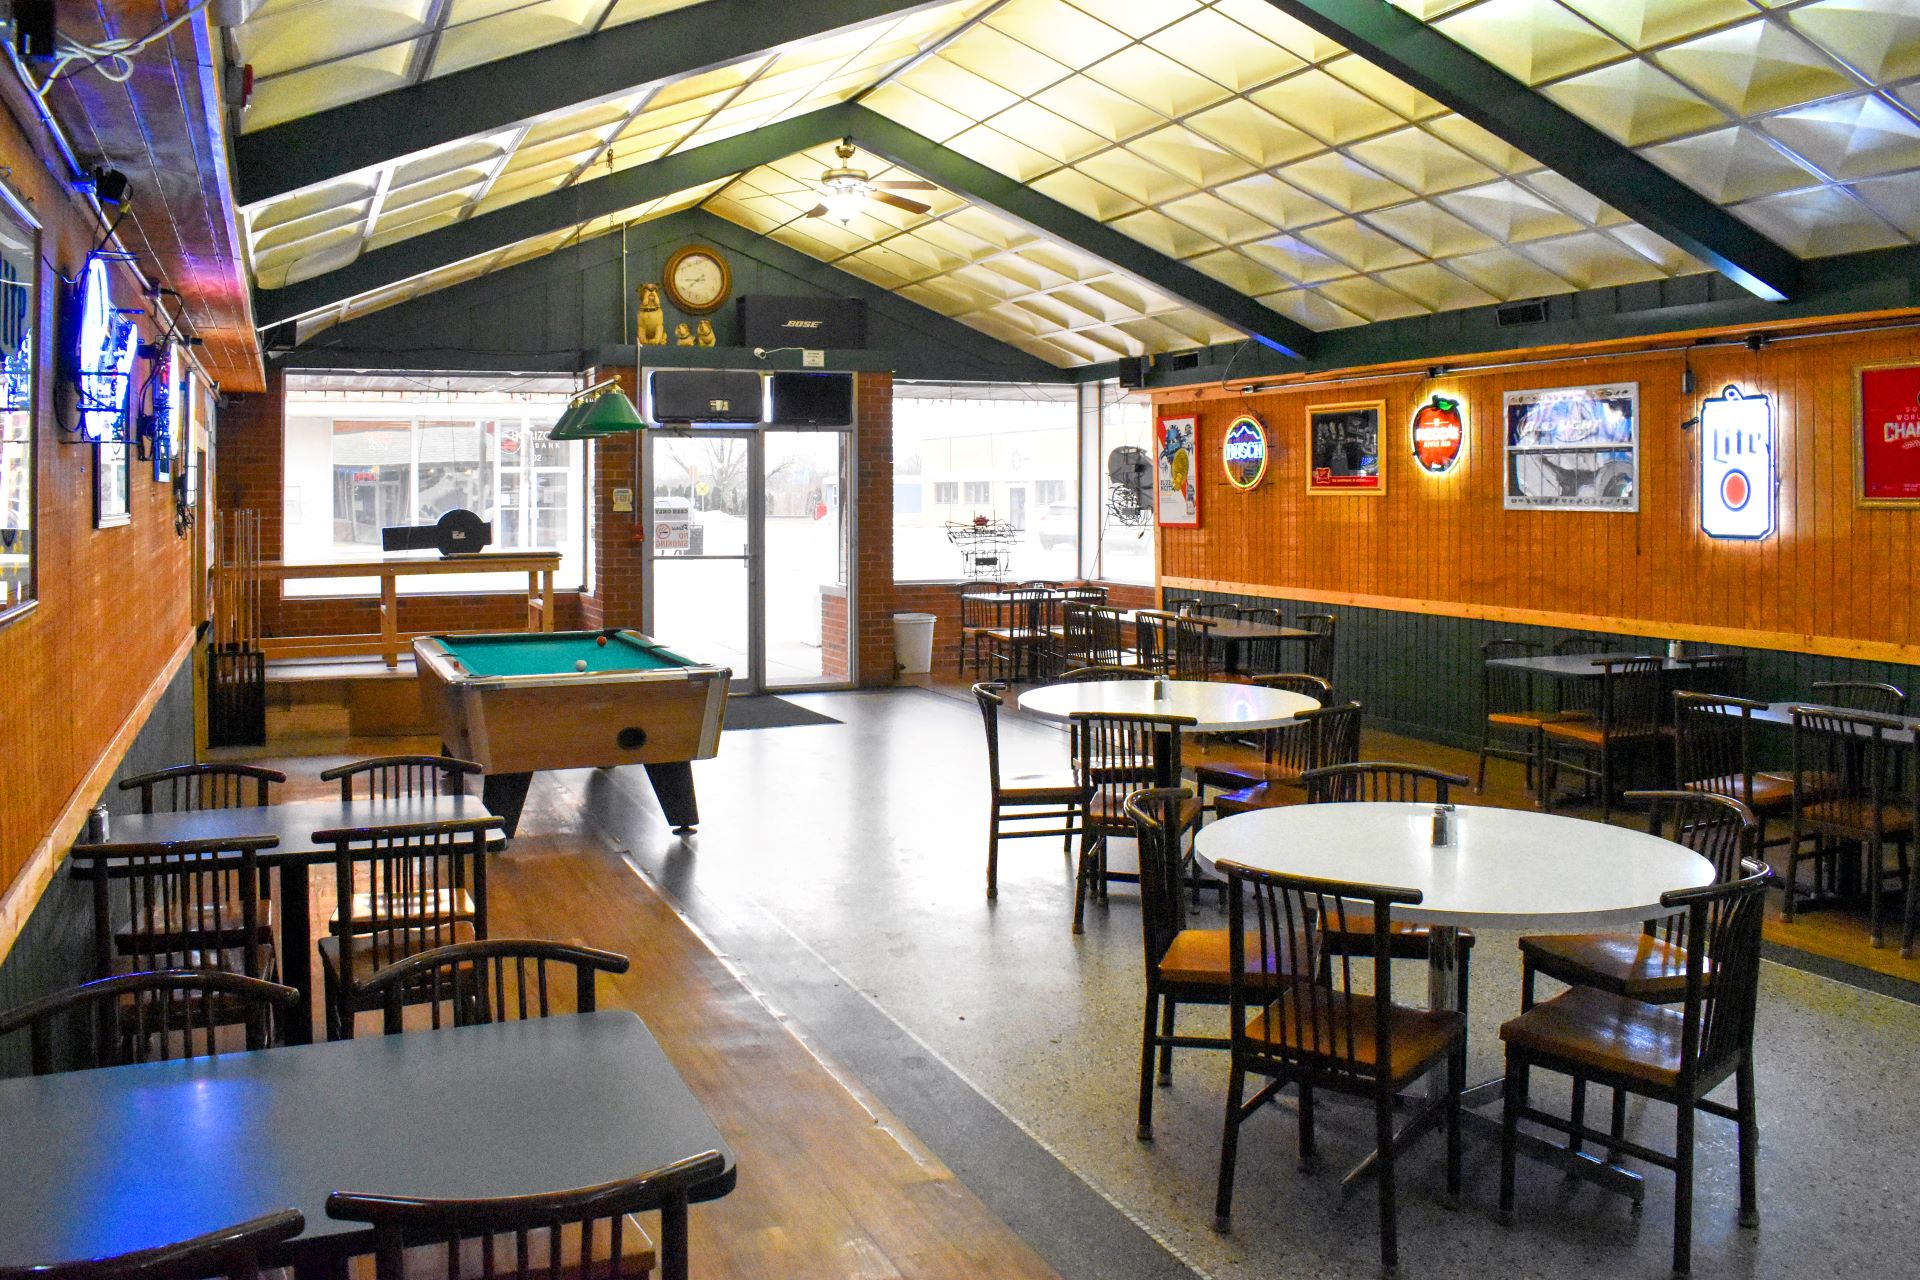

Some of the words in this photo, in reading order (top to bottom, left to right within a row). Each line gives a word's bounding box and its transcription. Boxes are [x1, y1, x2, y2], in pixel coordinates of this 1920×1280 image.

[782, 320, 822, 328] BOSE
[1226, 441, 1263, 460] BUSCH
[1713, 429, 1762, 463] Lite
